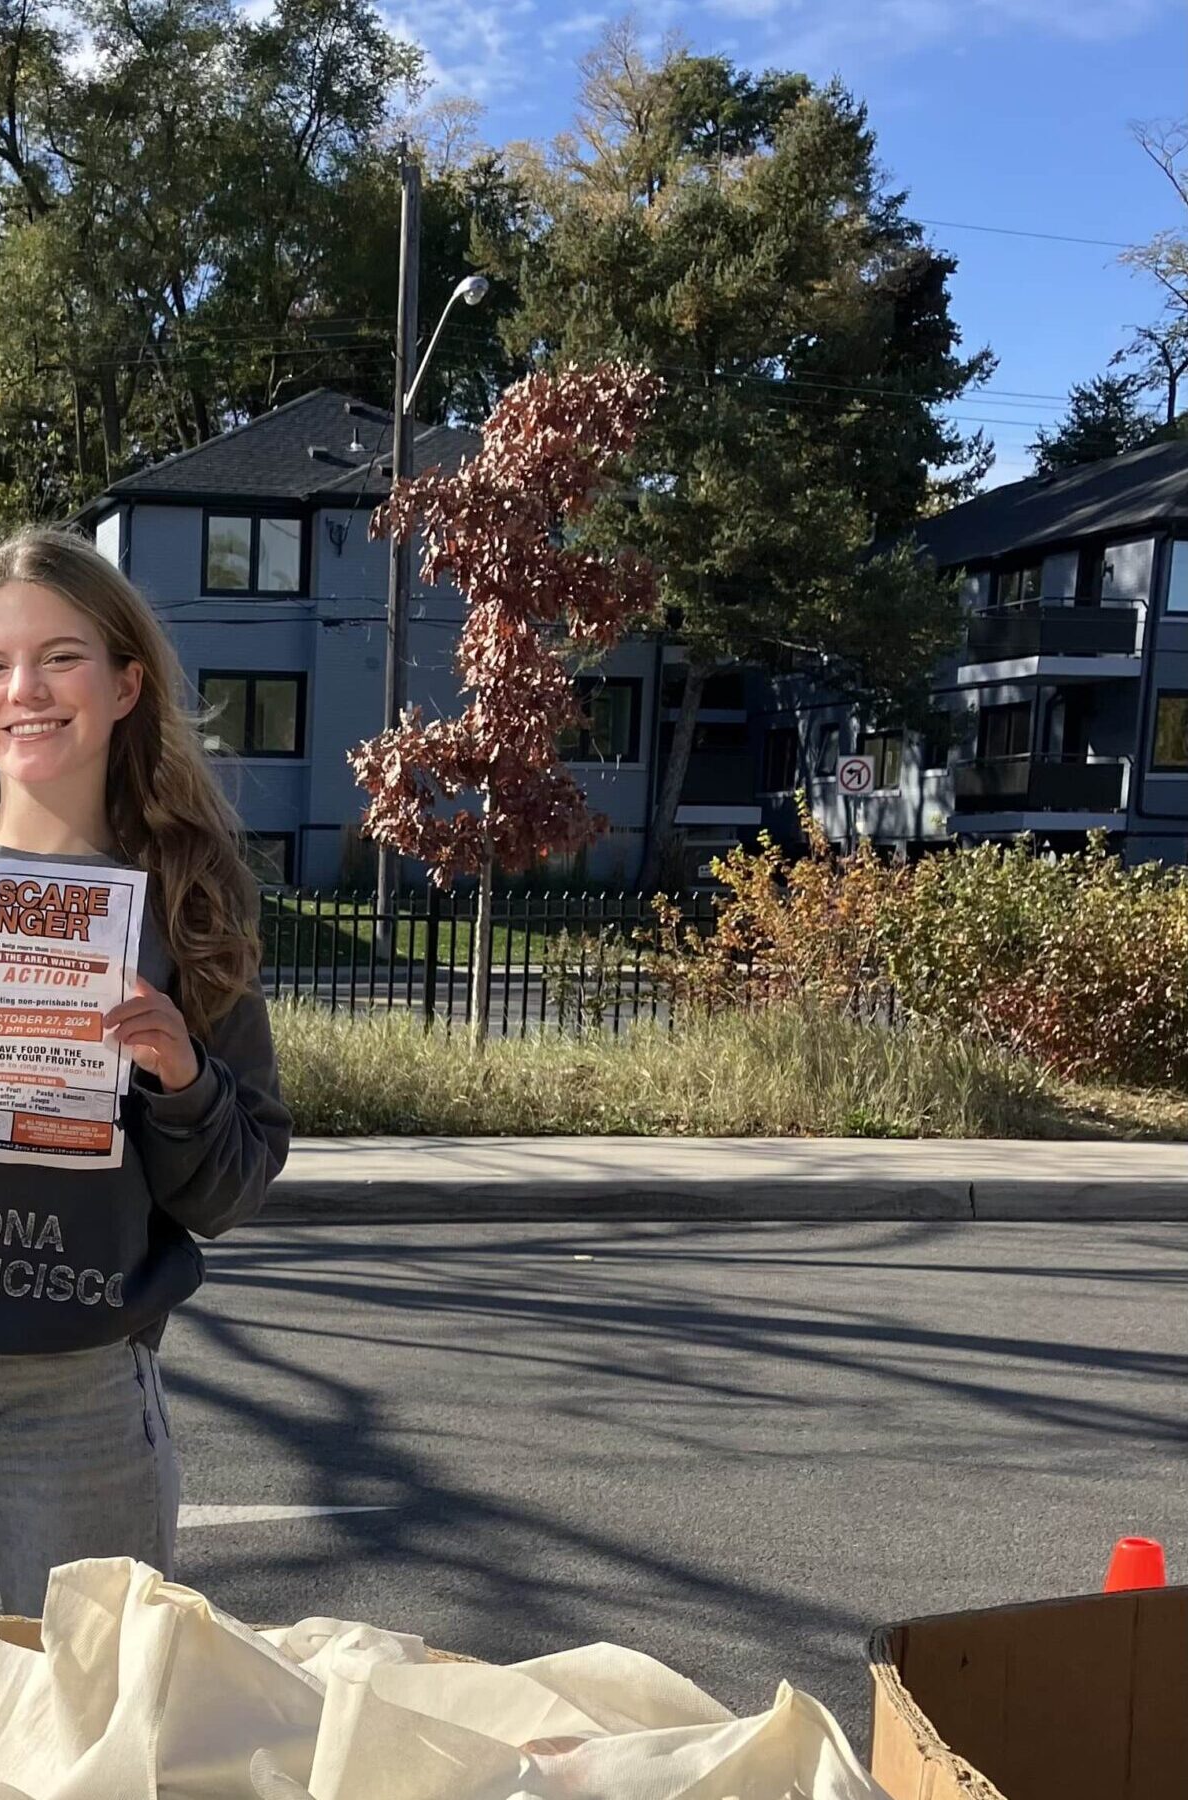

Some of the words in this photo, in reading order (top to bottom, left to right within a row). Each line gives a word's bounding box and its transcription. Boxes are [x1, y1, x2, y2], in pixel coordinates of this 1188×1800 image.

[5, 953, 21, 962] THE
[24, 955, 48, 965] AREA
[51, 958, 76, 968] WANT
[79, 962, 90, 970] TO
[3, 966, 90, 988] ACTION!
[18, 999, 77, 1009] non-perishable
[80, 1000, 98, 1008] food
[45, 1017, 61, 1027] 27,
[65, 1017, 92, 1027] 2024
[5, 1026, 23, 1035] pm
[26, 1026, 73, 1036] onwards
[21, 1045, 46, 1054] FOOD
[50, 1047, 60, 1055] IN
[64, 1048, 81, 1058] THE
[16, 1054, 42, 1062] YOUR
[45, 1055, 76, 1066] FRONT
[80, 1059, 104, 1069] STEP
[36, 1089, 54, 1097] Pasta
